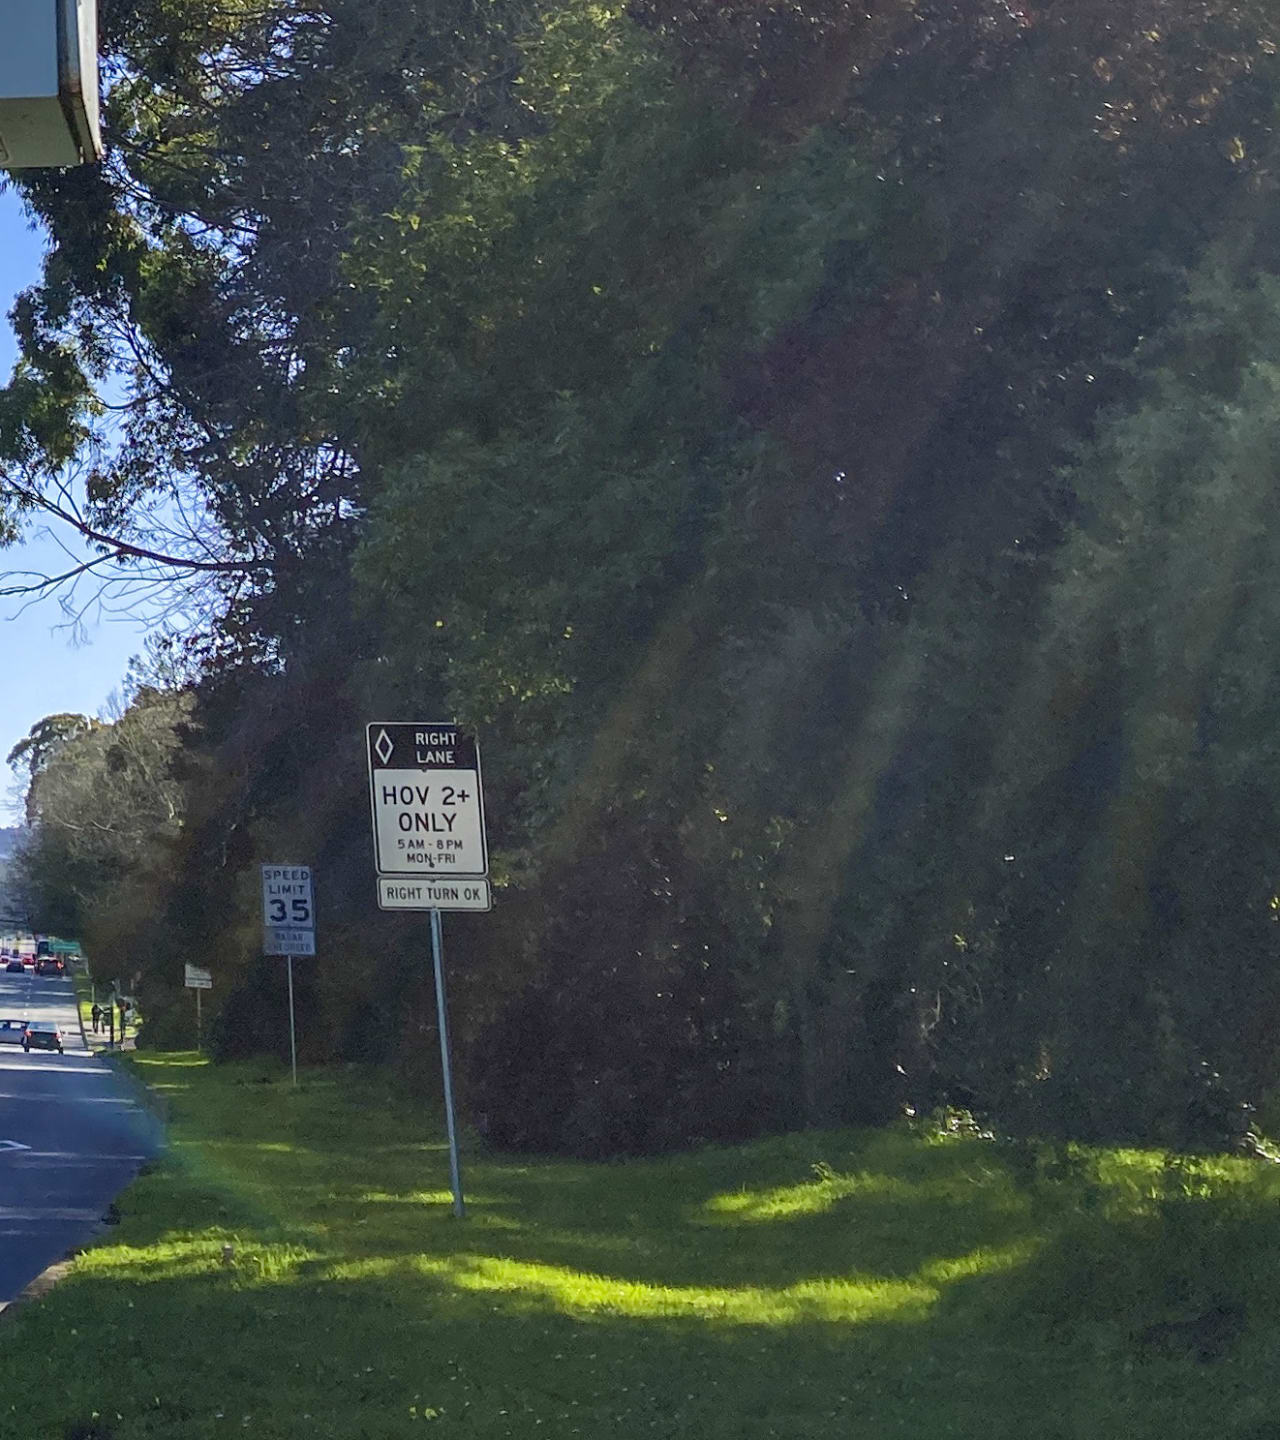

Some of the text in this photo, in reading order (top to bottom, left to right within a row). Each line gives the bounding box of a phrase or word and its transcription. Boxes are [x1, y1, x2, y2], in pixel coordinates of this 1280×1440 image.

[415, 732, 457, 746] RIGHT
[416, 751, 455, 764] LANE
[382, 786, 470, 806] HOV 2+
[398, 812, 457, 832] ONLY
[264, 870, 309, 880] SPEED
[269, 885, 305, 895] LIMIT
[386, 888, 481, 901] RIGHT TURN OK
[269, 899, 310, 922] 35
